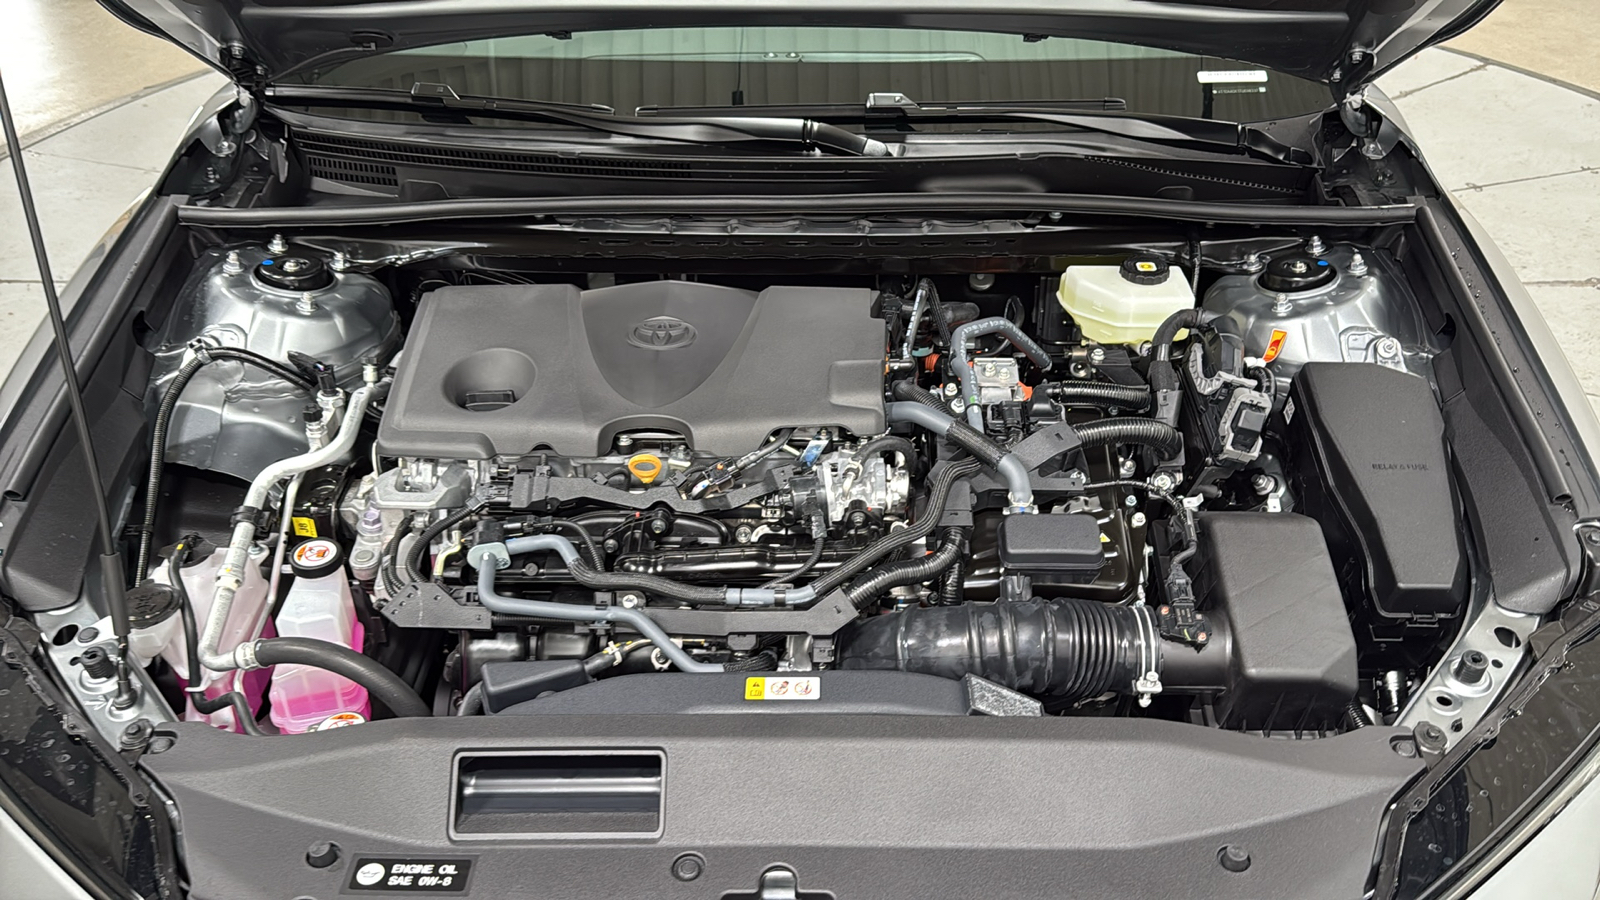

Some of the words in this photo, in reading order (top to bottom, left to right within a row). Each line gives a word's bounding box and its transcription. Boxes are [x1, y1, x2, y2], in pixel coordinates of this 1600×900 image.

[1407, 463, 1429, 471] FUSE
[391, 864, 435, 875] ENGINE
[438, 864, 458, 875] OIL
[387, 875, 413, 886] SAE
[418, 876, 453, 886] 0W-8
